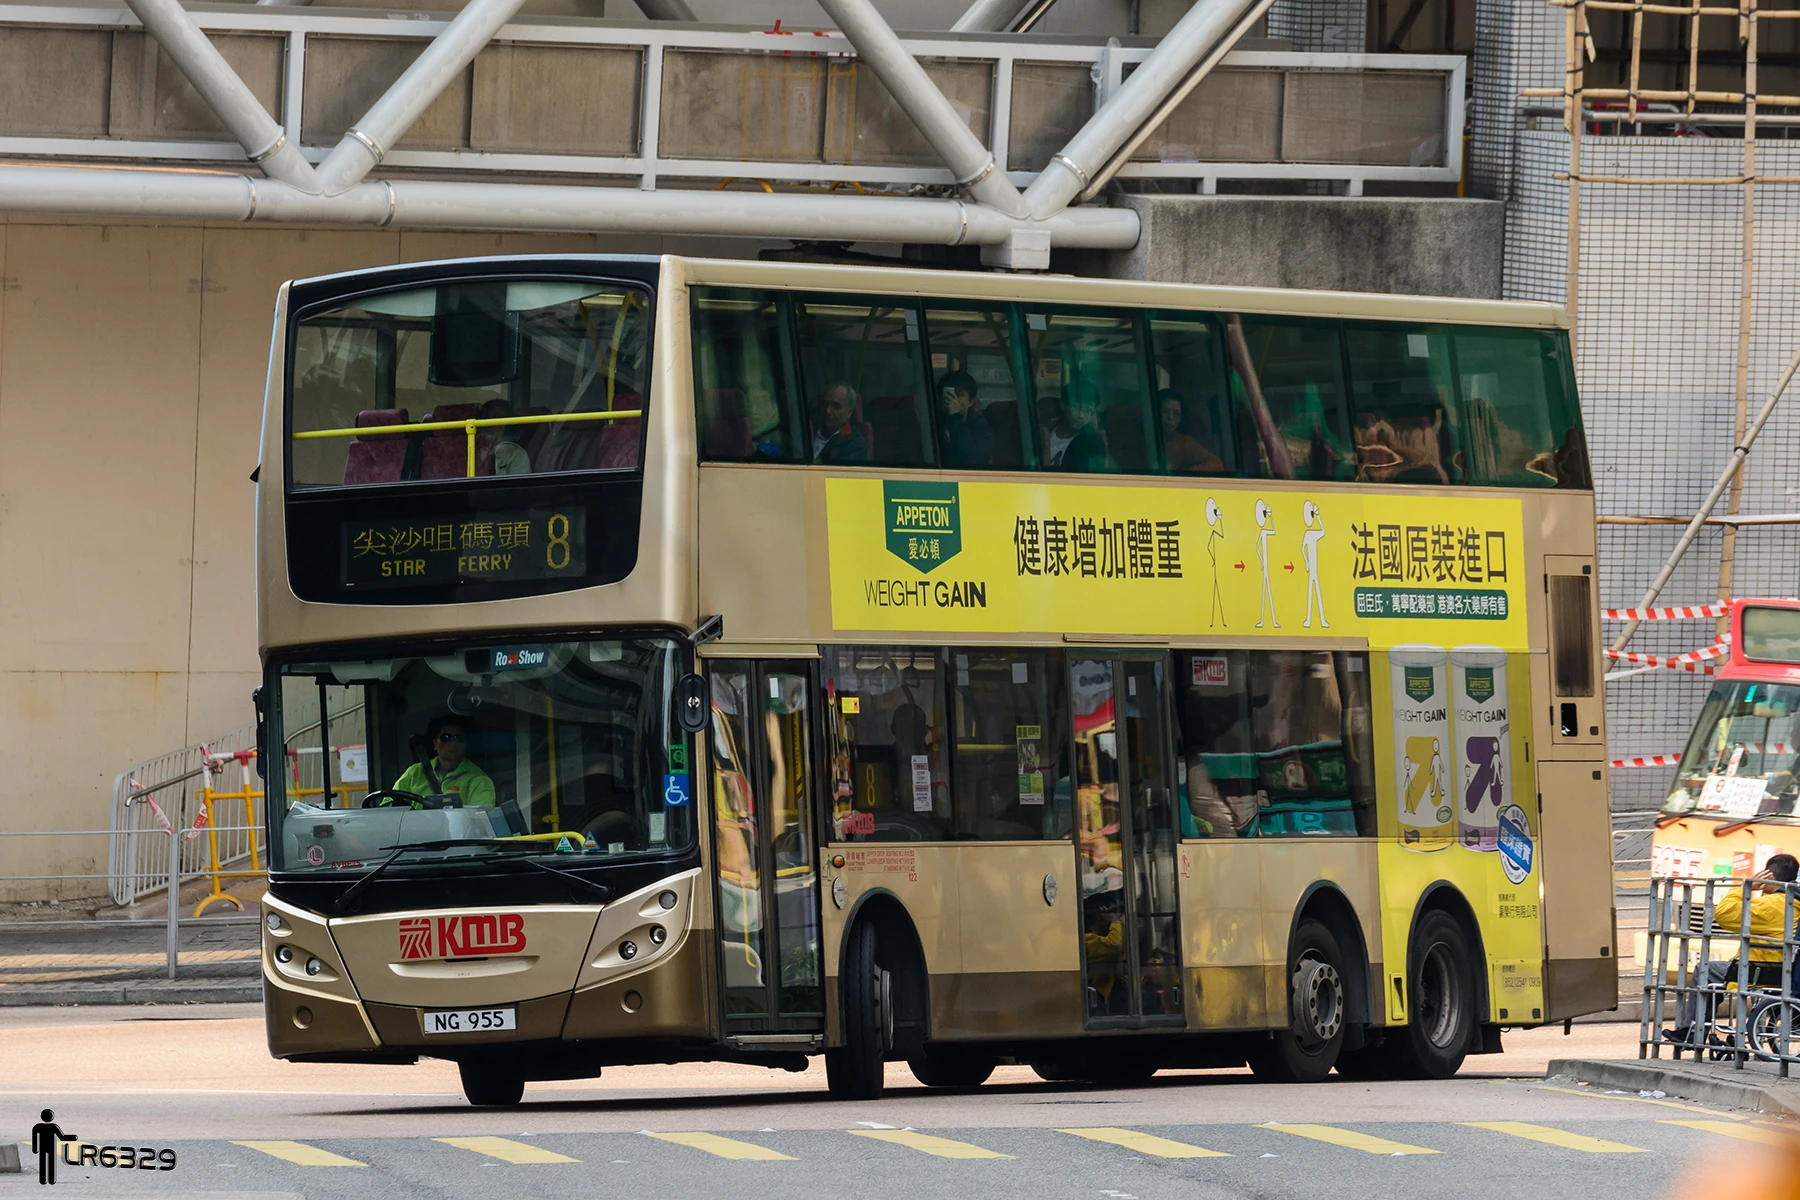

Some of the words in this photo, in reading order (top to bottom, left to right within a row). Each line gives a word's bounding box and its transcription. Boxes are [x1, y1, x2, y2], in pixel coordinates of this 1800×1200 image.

[896, 505, 949, 528] APPETON
[352, 519, 532, 559] 尖沙咀碼頭
[546, 513, 571, 570] 8
[907, 537, 941, 561] 愛必頓
[1013, 514, 1183, 580] 健康增加體重
[381, 559, 426, 577] STAR
[458, 553, 512, 573] FERRY
[1350, 522, 1508, 583] 法國原裝進口
[864, 579, 930, 607] WEIGHT
[934, 581, 987, 608] GAIN
[1424, 708, 1447, 722] GAIN
[1484, 708, 1507, 722] GAIN
[438, 913, 527, 957] KMB
[434, 1010, 460, 1030] NG
[467, 1010, 506, 1029] 955
